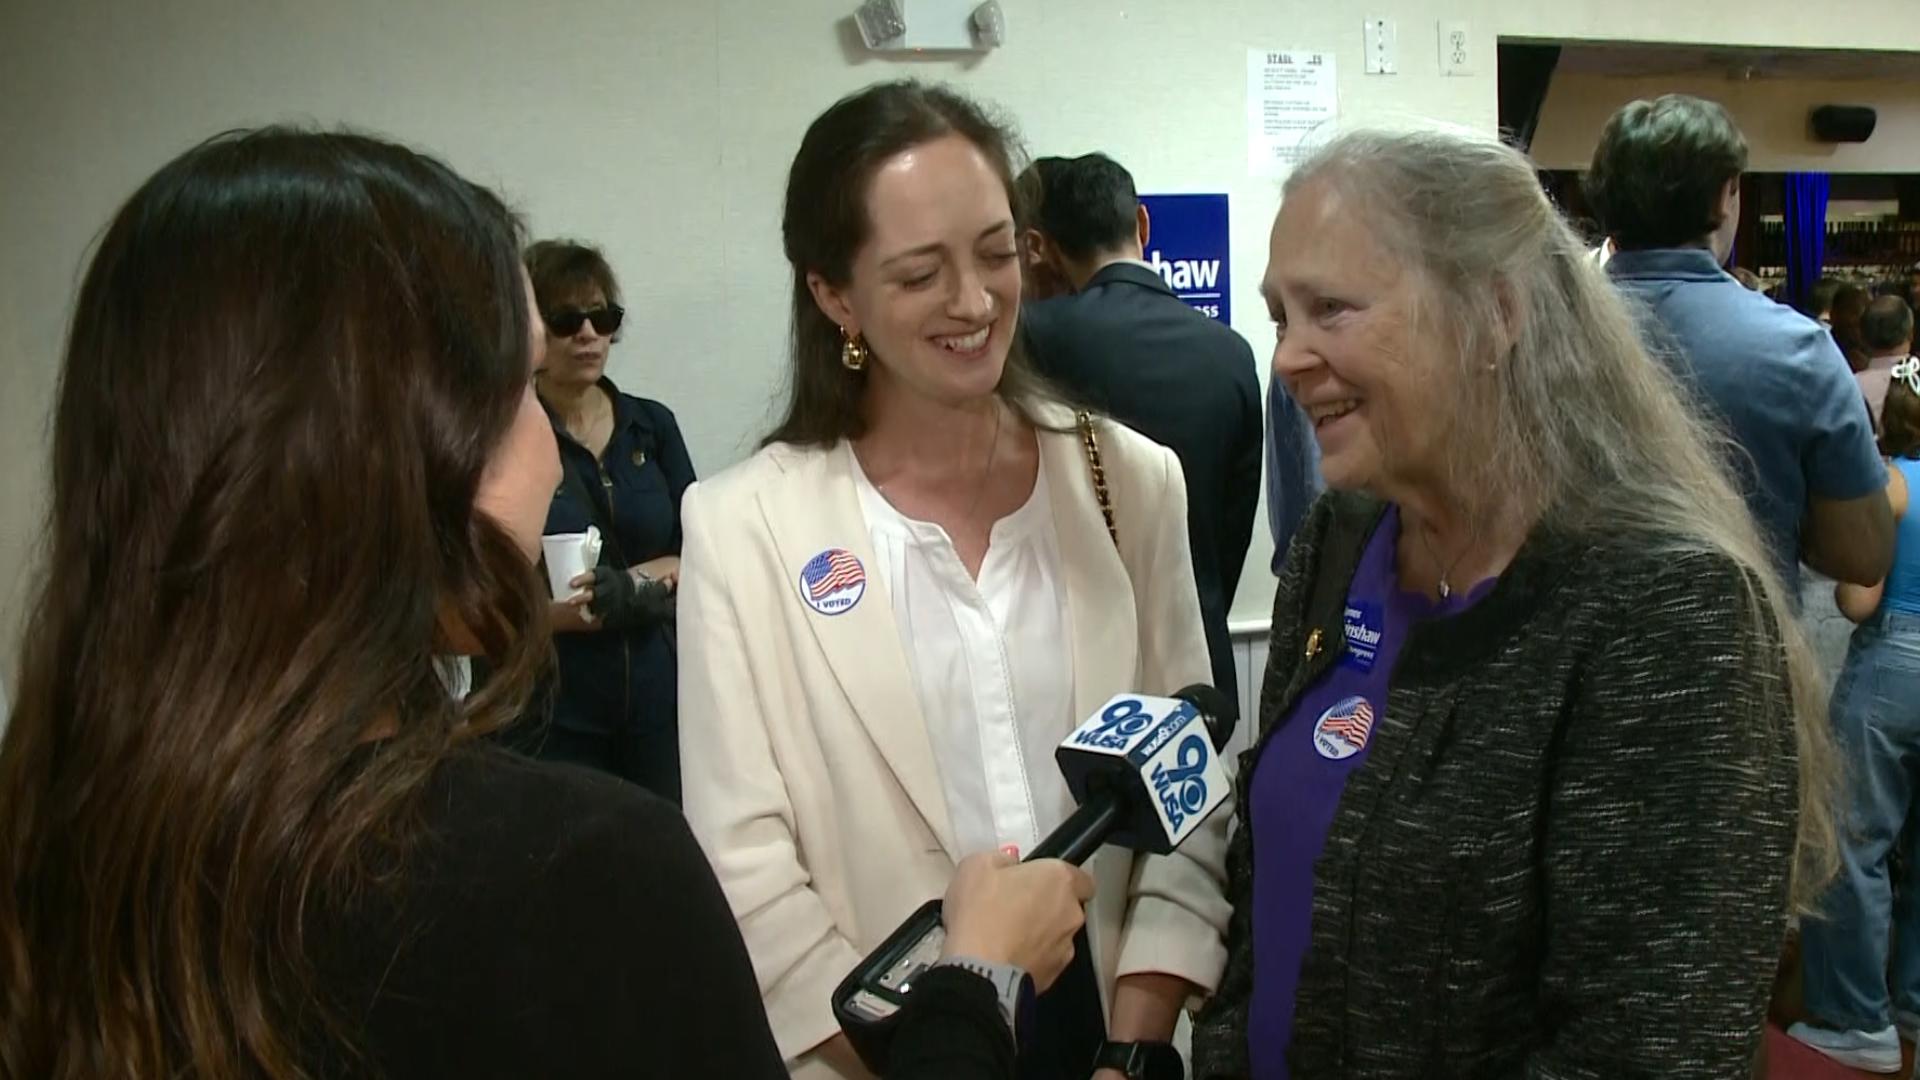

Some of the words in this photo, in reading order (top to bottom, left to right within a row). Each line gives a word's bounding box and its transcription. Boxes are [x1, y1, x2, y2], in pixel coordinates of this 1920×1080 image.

[823, 598, 851, 608] VOTED
[1074, 731, 1129, 750] WUSA
[1167, 734, 1208, 783] 9
[1151, 762, 1184, 834] WUSA
